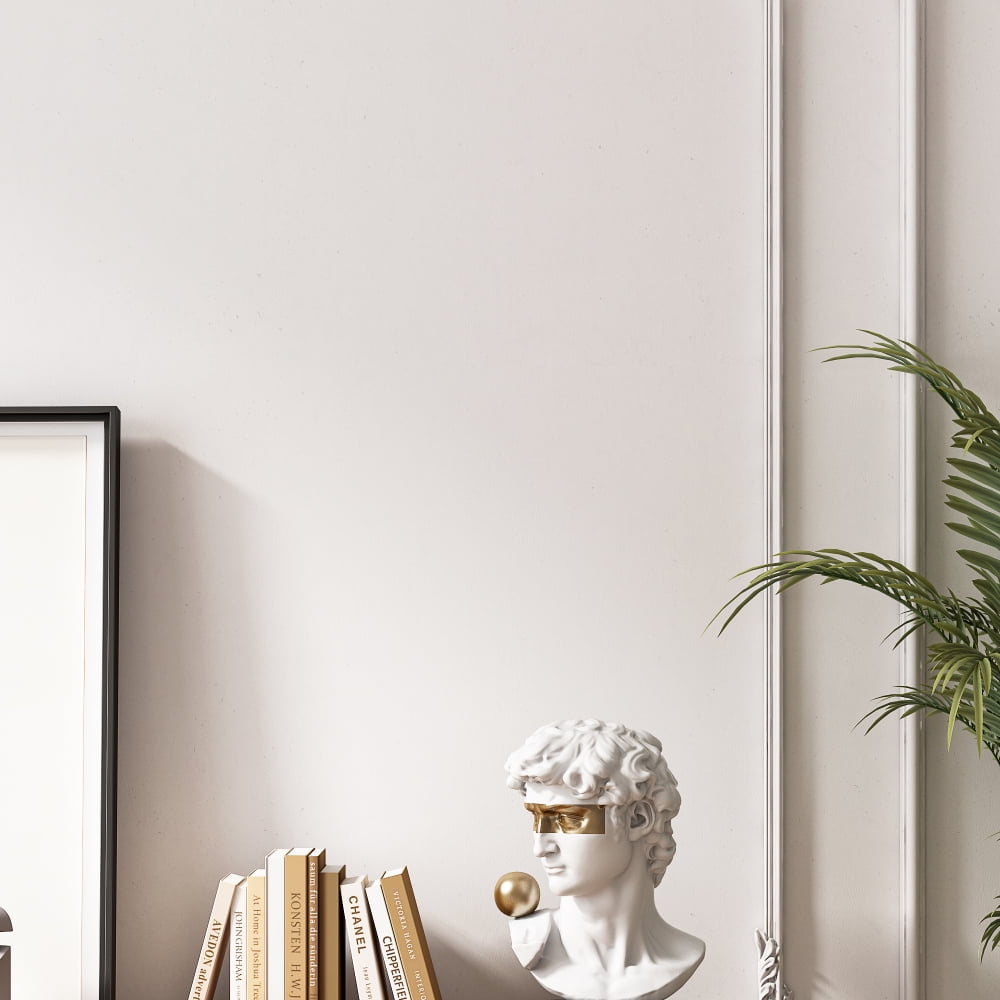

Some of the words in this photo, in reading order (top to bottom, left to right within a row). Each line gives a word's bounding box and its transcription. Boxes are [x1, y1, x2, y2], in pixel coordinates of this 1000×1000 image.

[252, 895, 261, 906] At
[392, 890, 406, 930] VICTORIA
[253, 909, 262, 935] Home
[290, 892, 302, 954] KONSTEN
[348, 895, 368, 954] CHANEL
[202, 918, 223, 968] AVEDON
[253, 938, 262, 946] in
[250, 947, 262, 979] Joshua
